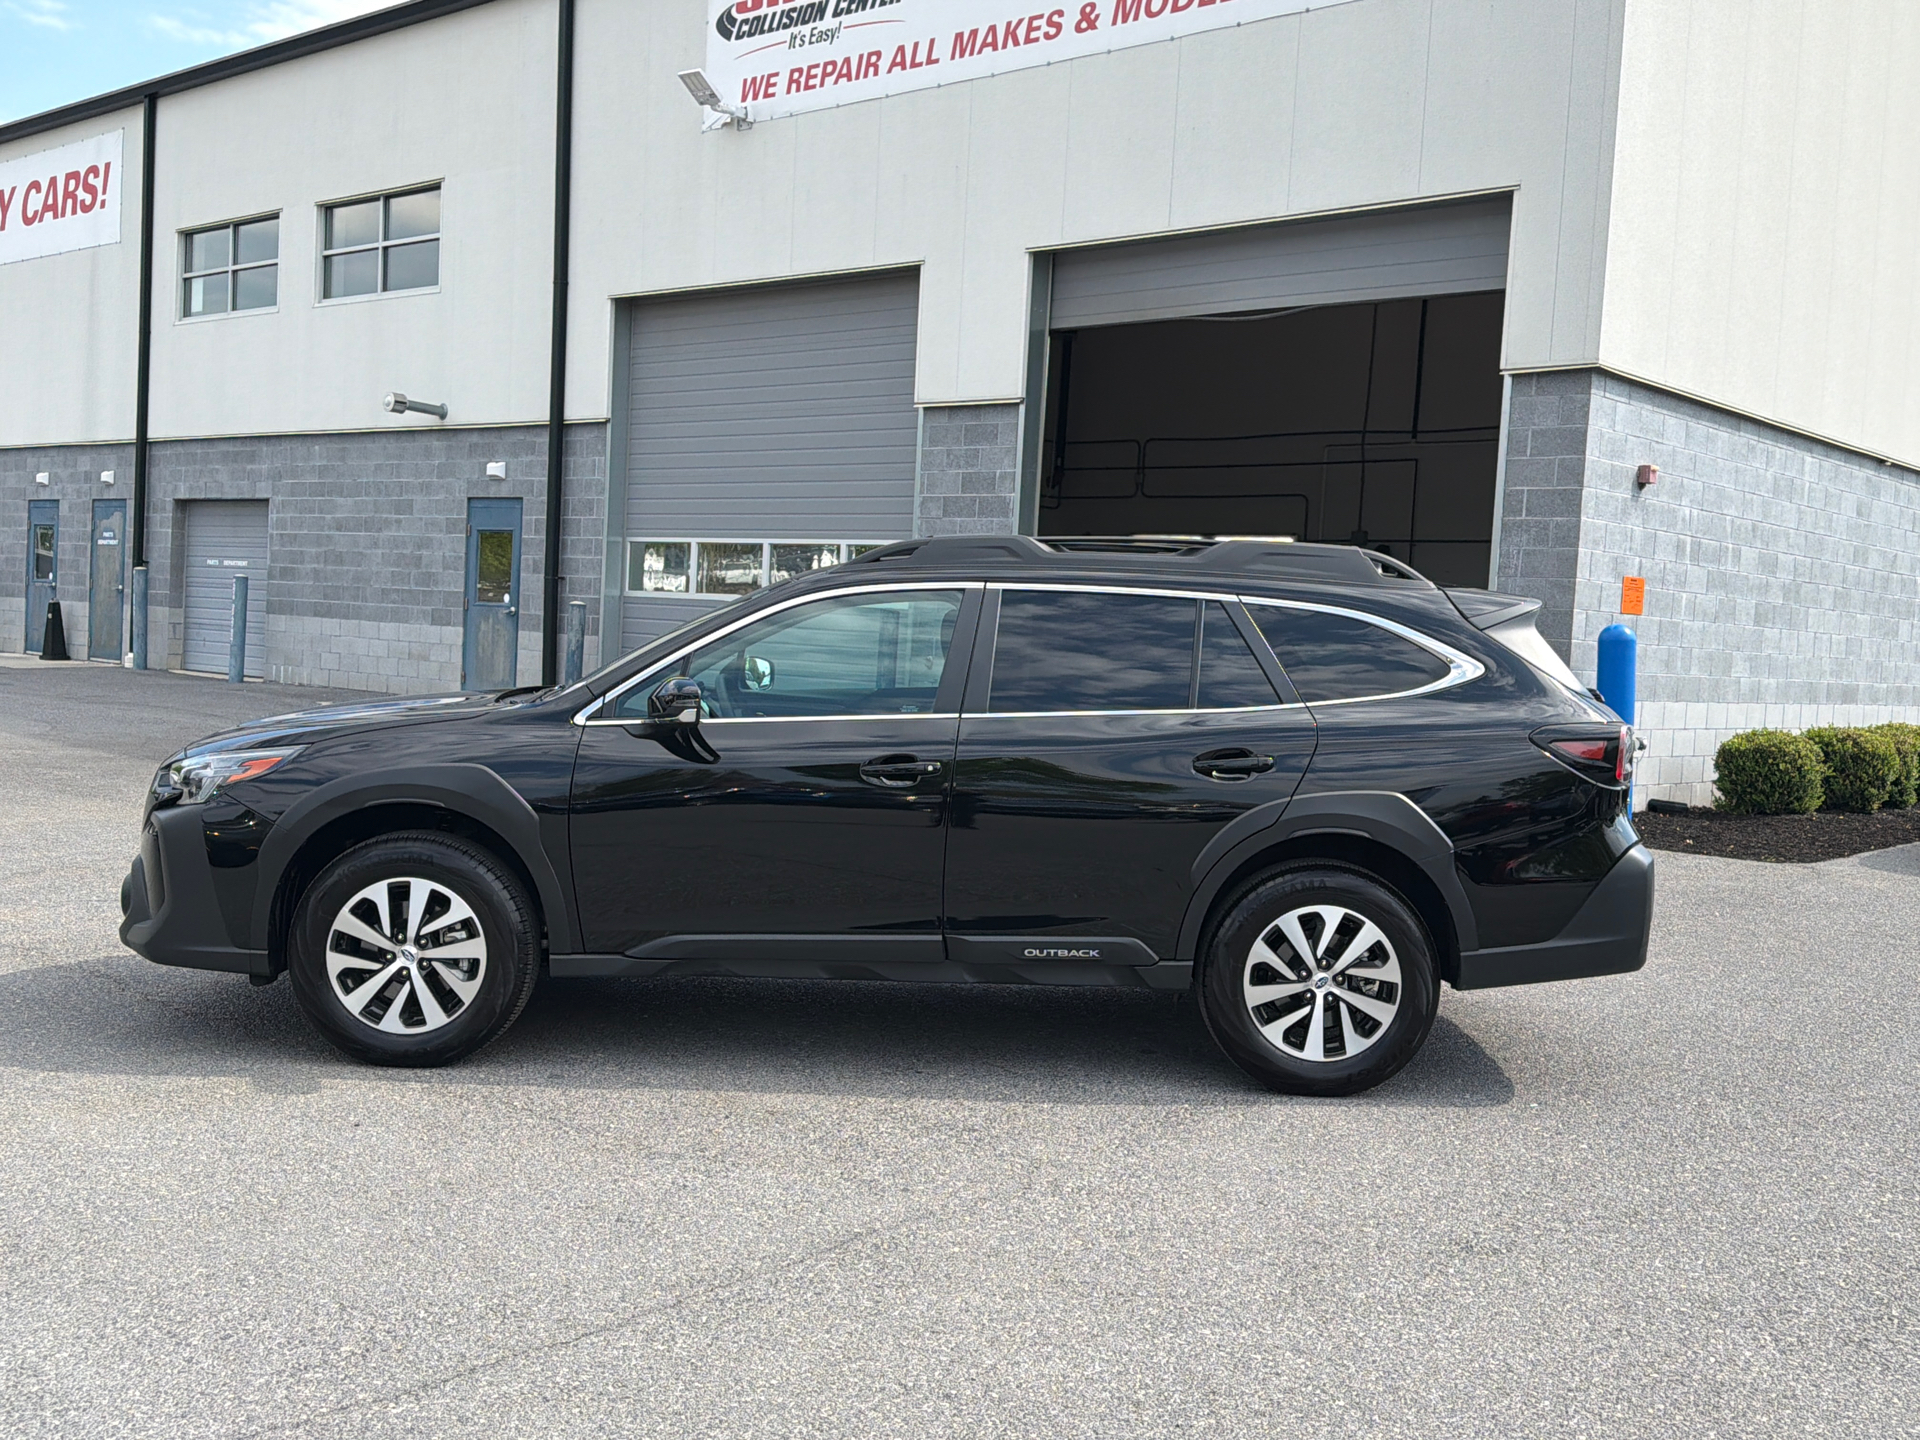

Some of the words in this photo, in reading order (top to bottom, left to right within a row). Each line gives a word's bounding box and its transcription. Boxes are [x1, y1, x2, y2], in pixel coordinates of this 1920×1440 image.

[734, 0, 830, 41] COLLISION
[831, 0, 902, 18] CEN
[788, 29, 806, 50] It's
[808, 21, 842, 46] Easy!
[740, 71, 780, 103] WE
[785, 50, 882, 95] REPAIR
[886, 37, 940, 74] ALL
[950, 9, 1065, 61] MAKES
[1074, 2, 1101, 34] &
[21, 161, 111, 226] CARS!
[1023, 948, 1100, 958] OUTBACK
